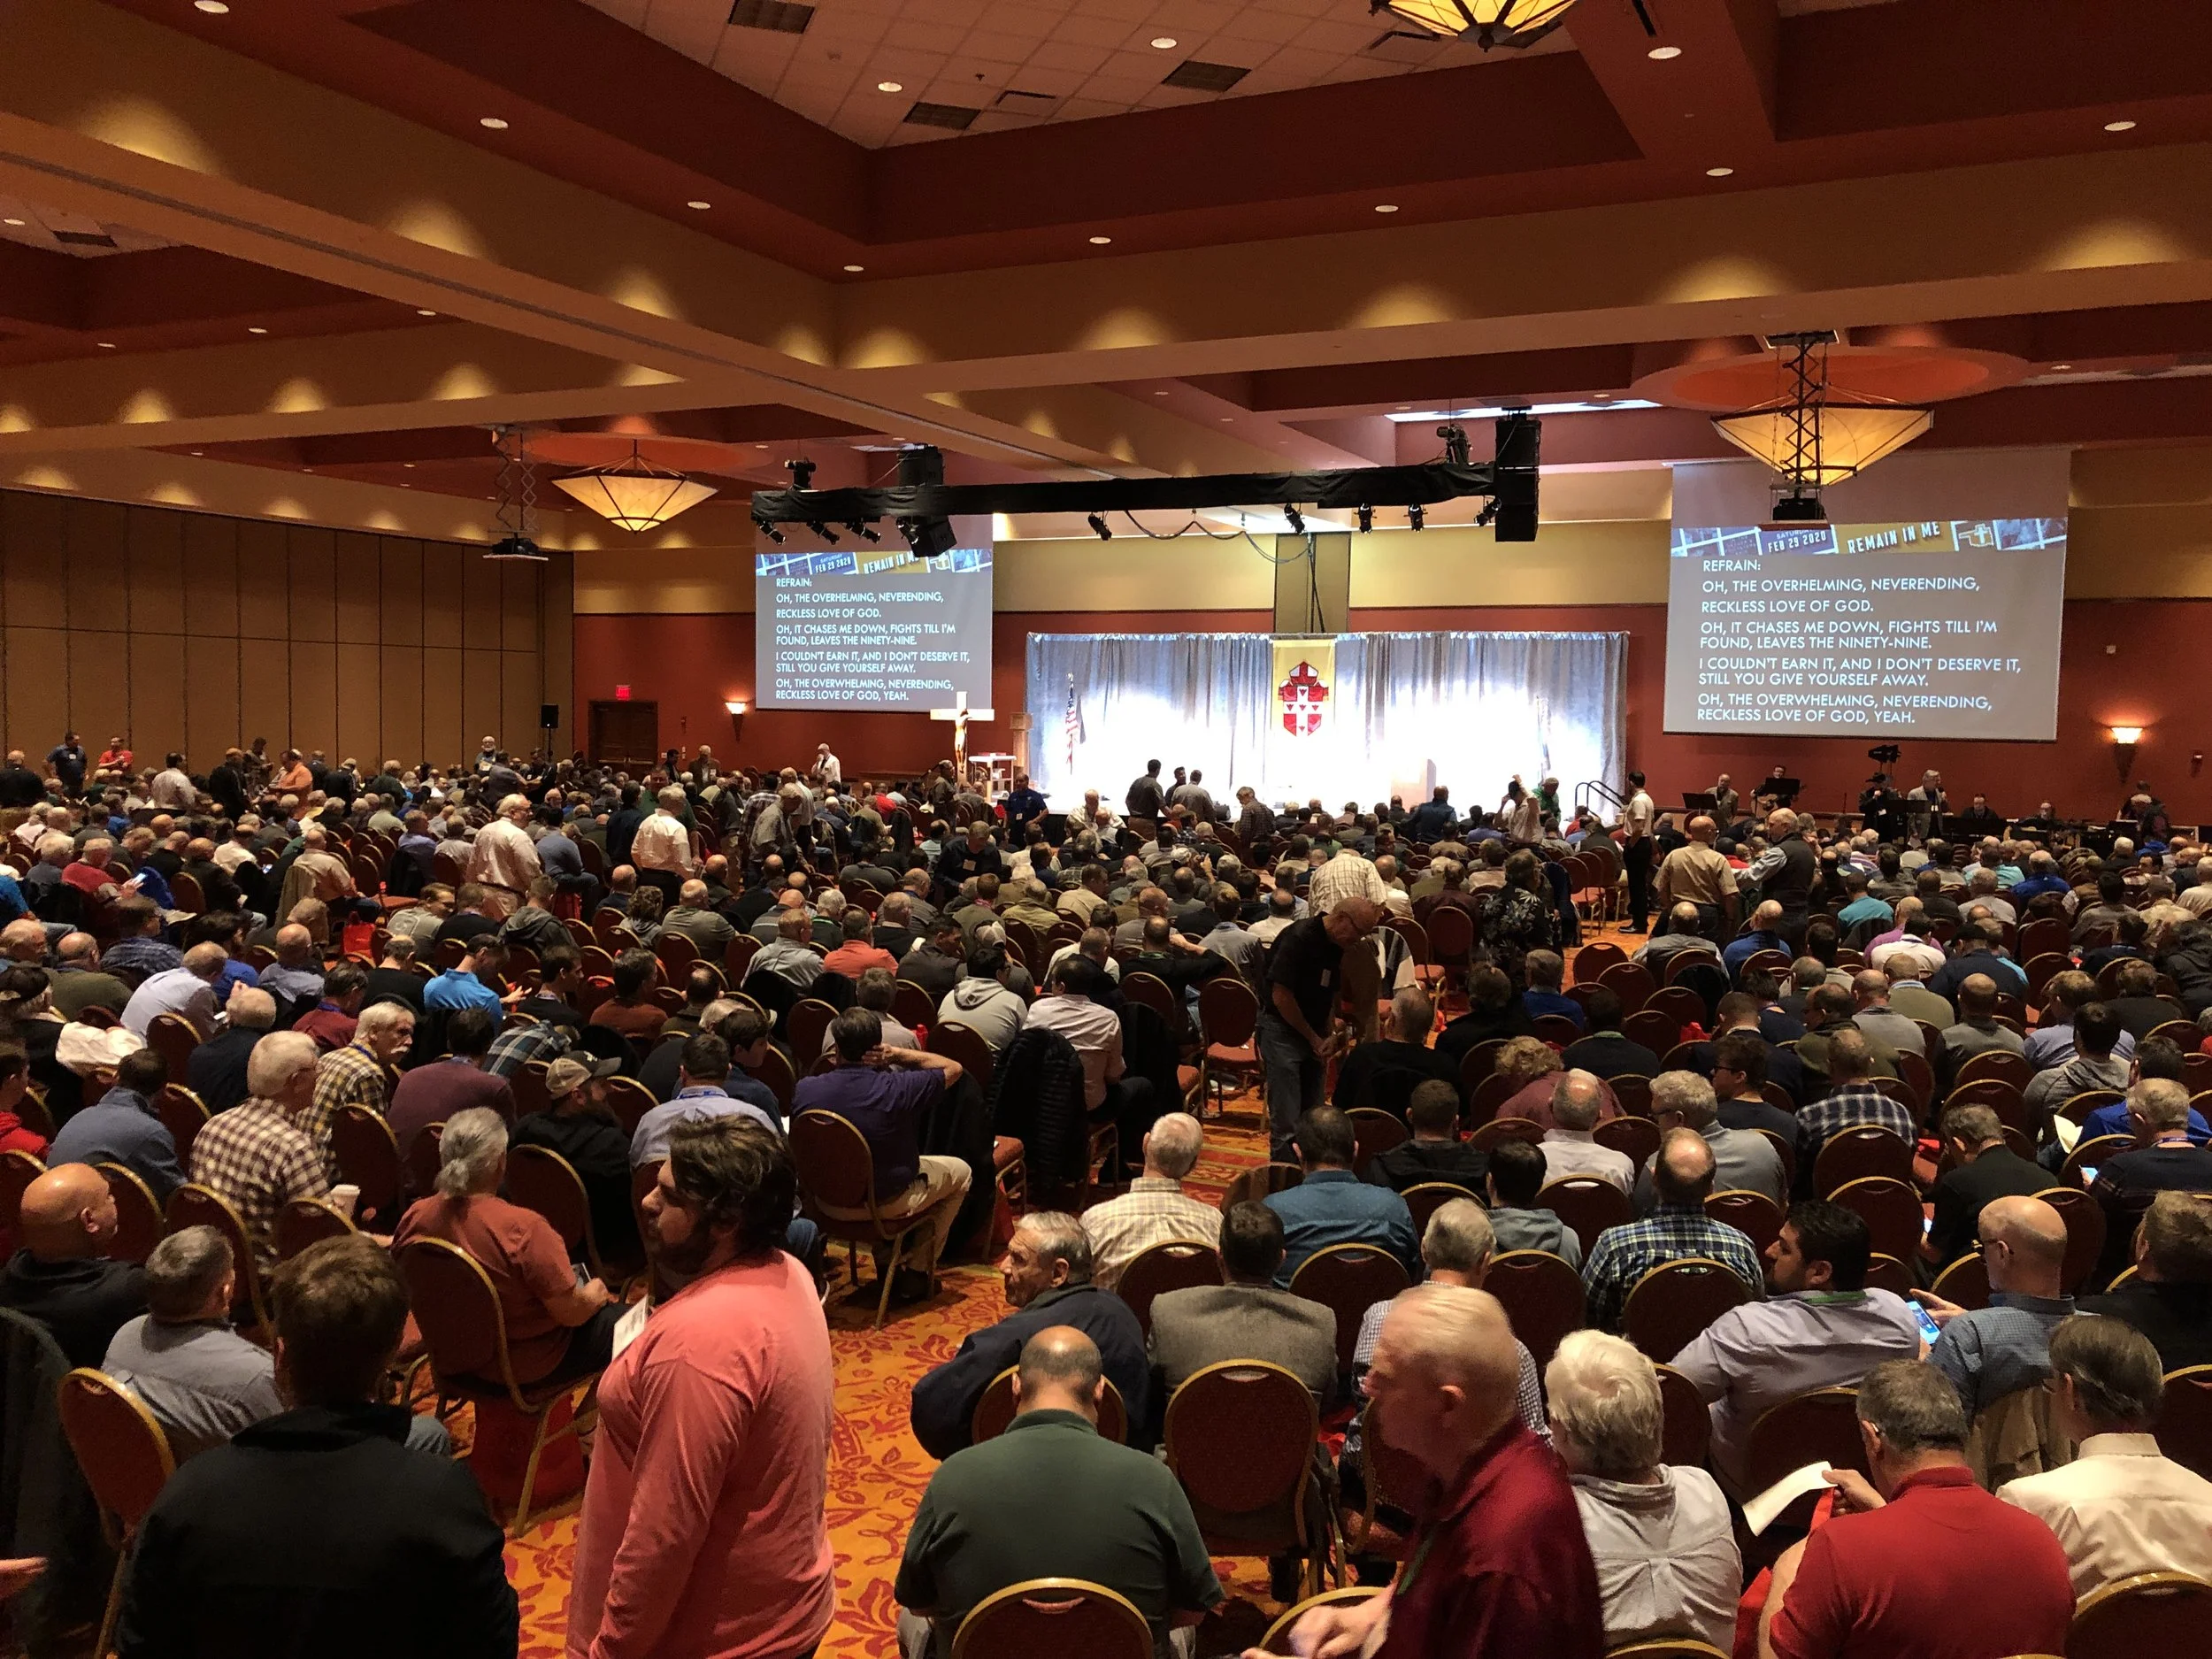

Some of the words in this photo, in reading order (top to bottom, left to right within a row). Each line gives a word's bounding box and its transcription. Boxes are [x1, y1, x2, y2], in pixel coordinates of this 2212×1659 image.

[1768, 540, 1785, 553] FEB
[1788, 537, 1799, 549] 29
[1802, 531, 1826, 545] 2020
[1847, 529, 1898, 554] REMAIN
[1902, 525, 1916, 542] IN
[1921, 521, 1940, 538] ME
[815, 564, 826, 573] FEB
[864, 556, 895, 574] REMAIN
[896, 553, 905, 565] IN
[1704, 559, 1761, 572] REFRAIN:
[777, 578, 811, 587] REFRAIN:
[1702, 580, 1727, 595] OH,
[1732, 580, 1756, 592] THE
[1762, 579, 1866, 593] OVERHELMING,
[1871, 577, 1979, 591] NEVERENDING,
[776, 594, 792, 603] OH,
[795, 594, 810, 603] THE
[812, 593, 876, 603] OVERHELMING,
[879, 592, 943, 603] NEVERENDING,
[1702, 601, 1765, 612] RECKLESS
[1770, 601, 1805, 612] LOVE
[1810, 600, 1830, 612] OF
[1835, 600, 1873, 611] GOD.
[777, 609, 816, 618] RECKLESS
[818, 609, 840, 618] LOVE
[842, 609, 855, 618] OF
[857, 609, 881, 618] GOD.
[777, 625, 792, 635] OH,
[795, 625, 802, 634] IT
[804, 625, 837, 634] CHASES
[840, 625, 851, 634] ME
[855, 624, 887, 634] DOWN,
[890, 624, 921, 634] FIGHTS
[924, 624, 940, 634] TILL
[941, 624, 956, 634] I'M
[1701, 622, 1726, 635] OH,
[1732, 622, 1741, 634] IT
[1747, 621, 1800, 634] CHASES
[1804, 621, 1824, 633] ME
[1830, 621, 1883, 635] DOWN,
[1889, 621, 1939, 633] FIGHTS
[1946, 621, 1970, 633] TILL
[1977, 621, 1997, 632] I'M
[777, 636, 809, 646] FOUND,
[811, 636, 841, 645] LEAVES
[842, 636, 858, 645] THE
[861, 636, 917, 645] NINETY-NINE.
[1701, 637, 1753, 650] FOUND,
[1757, 637, 1805, 649] LEAVES
[1809, 637, 1833, 648] THE
[1839, 637, 1932, 648] NINETY-NINE.
[781, 651, 824, 660] COULDN'T
[826, 651, 849, 660] EARN
[890, 651, 918, 661] DON'T
[920, 651, 957, 661] DESERVE
[960, 652, 970, 664] IT,
[776, 664, 795, 672] STILL
[798, 664, 817, 672] YOU
[819, 663, 840, 672] GIVE
[843, 664, 885, 672] YOURSELF
[887, 664, 916, 672] AWAY.
[1708, 657, 1778, 670] COULDN'T
[1782, 658, 1817, 669] EARN
[1824, 658, 1836, 672] IT,
[1840, 658, 1871, 670] AND
[1886, 658, 1932, 670] DON'T
[1938, 658, 2001, 671] DESERVE
[2007, 659, 2020, 672] IT,
[776, 679, 792, 688] OH,
[795, 679, 810, 687] THE
[812, 679, 886, 691] OVERWHELMING,
[888, 680, 954, 690] NEVERENDING,
[1699, 672, 1730, 685] STILL
[1734, 672, 1764, 685] YOU
[1770, 673, 1802, 685] GIVE
[1809, 673, 1878, 685] YOURSELF
[1882, 674, 1928, 686] AWAY.
[776, 690, 815, 699] RECKLESS
[818, 690, 840, 699] LOVE
[842, 691, 855, 700] OF
[857, 691, 880, 701] GOD,
[884, 691, 909, 700] YEAH.
[1698, 694, 1724, 707] OH,
[1728, 694, 1752, 705] THE
[1757, 694, 1878, 708] OVERWHELMING,
[1883, 695, 1992, 710] NEVERENDING,
[1698, 709, 1761, 721] RECKLESS
[1766, 710, 1801, 721] LOVE
[1805, 710, 1825, 721] OF
[1831, 710, 1869, 725] GOD,
[1874, 711, 1915, 723] YEAH.
